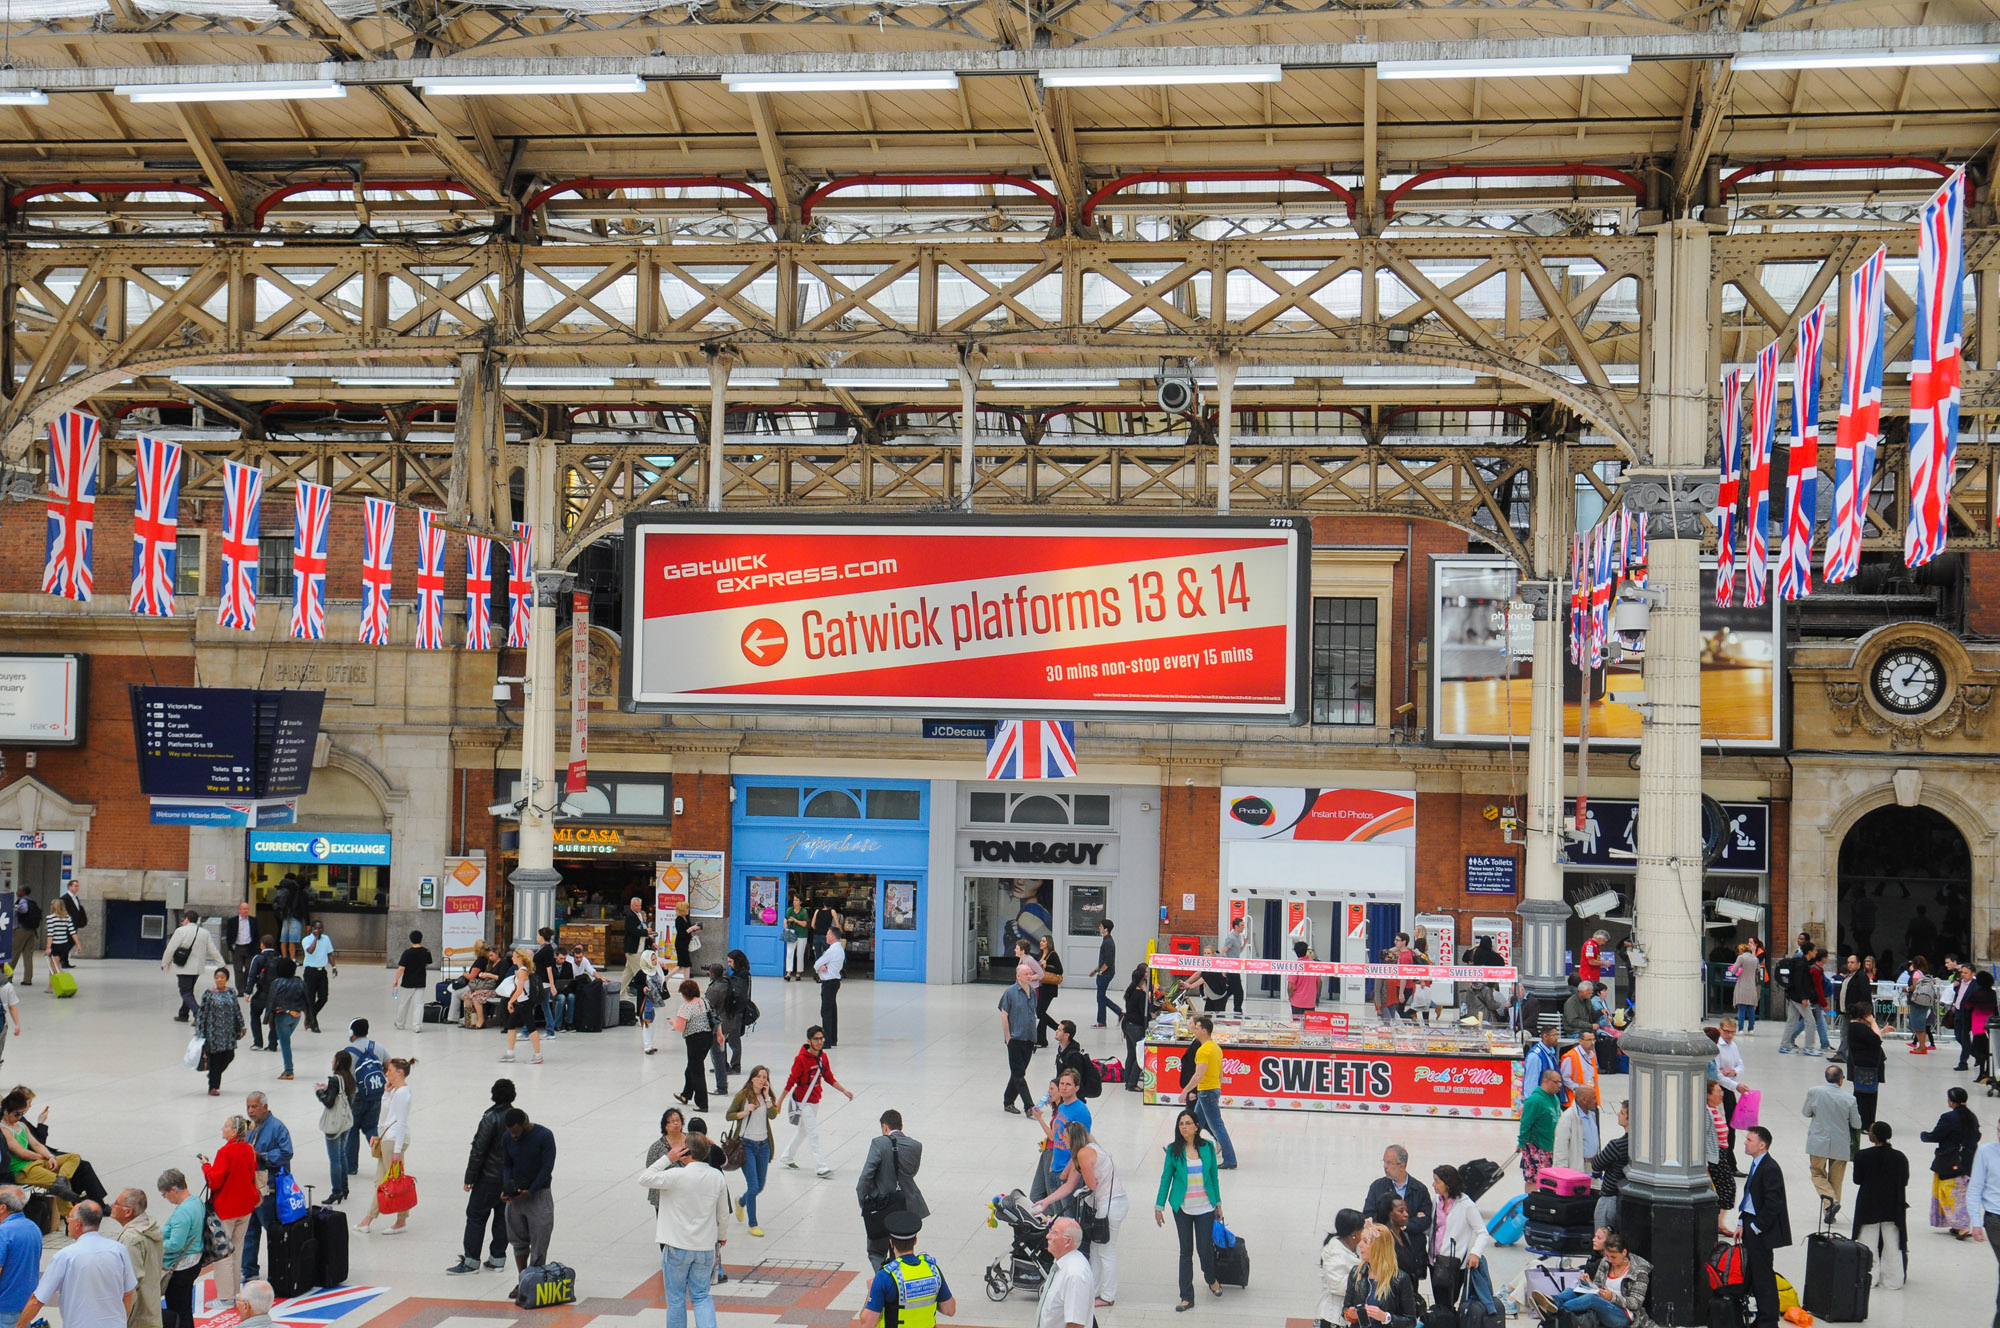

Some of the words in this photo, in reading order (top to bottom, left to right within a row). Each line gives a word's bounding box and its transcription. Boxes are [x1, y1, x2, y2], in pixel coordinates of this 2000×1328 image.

[1269, 518, 1293, 528] 2779
[802, 596, 943, 660] Gatwick
[951, 585, 1122, 651] platforms
[1128, 570, 1166, 623] 13
[1176, 567, 1207, 619] &
[1211, 561, 1251, 615] 14
[1508, 601, 1532, 610] Turn
[1521, 623, 1532, 631] to
[1046, 664, 1063, 682] 30
[1066, 662, 1098, 681] mins
[1101, 657, 1160, 677] non-stop
[1163, 653, 1200, 670] every
[1203, 649, 1217, 666] 15
[1221, 647, 1254, 664] mins
[275, 664, 321, 682] PARCEL
[326, 665, 368, 683] OFFICE
[931, 726, 986, 737] JCDecaux
[210, 812, 231, 820] Station
[1311, 810, 1337, 818] Instant
[1347, 811, 1374, 819] Photos
[553, 828, 572, 842] MI
[575, 829, 620, 843] CASA
[254, 841, 309, 853] CURRENCY
[330, 843, 385, 854] EXCHANGE
[558, 844, 612, 853] BURRITOS
[784, 830, 882, 861] Paperchase
[969, 839, 1104, 865] TONI&GUY
[1490, 858, 1513, 866] Toilets
[452, 900, 479, 910] bien!
[1178, 957, 1212, 967] SWEETS
[1271, 962, 1304, 971] SWEETS
[1364, 966, 1398, 975] SWEETS
[1450, 968, 1484, 977] SWEETS
[1875, 1000, 1897, 1014] fresh
[1260, 1056, 1392, 1098] SWEETS
[1414, 1065, 1450, 1082] Pick
[1469, 1067, 1503, 1085] Mix
[1453, 1086, 1485, 1094] SERVICE
[536, 1279, 572, 1306] NIKE
